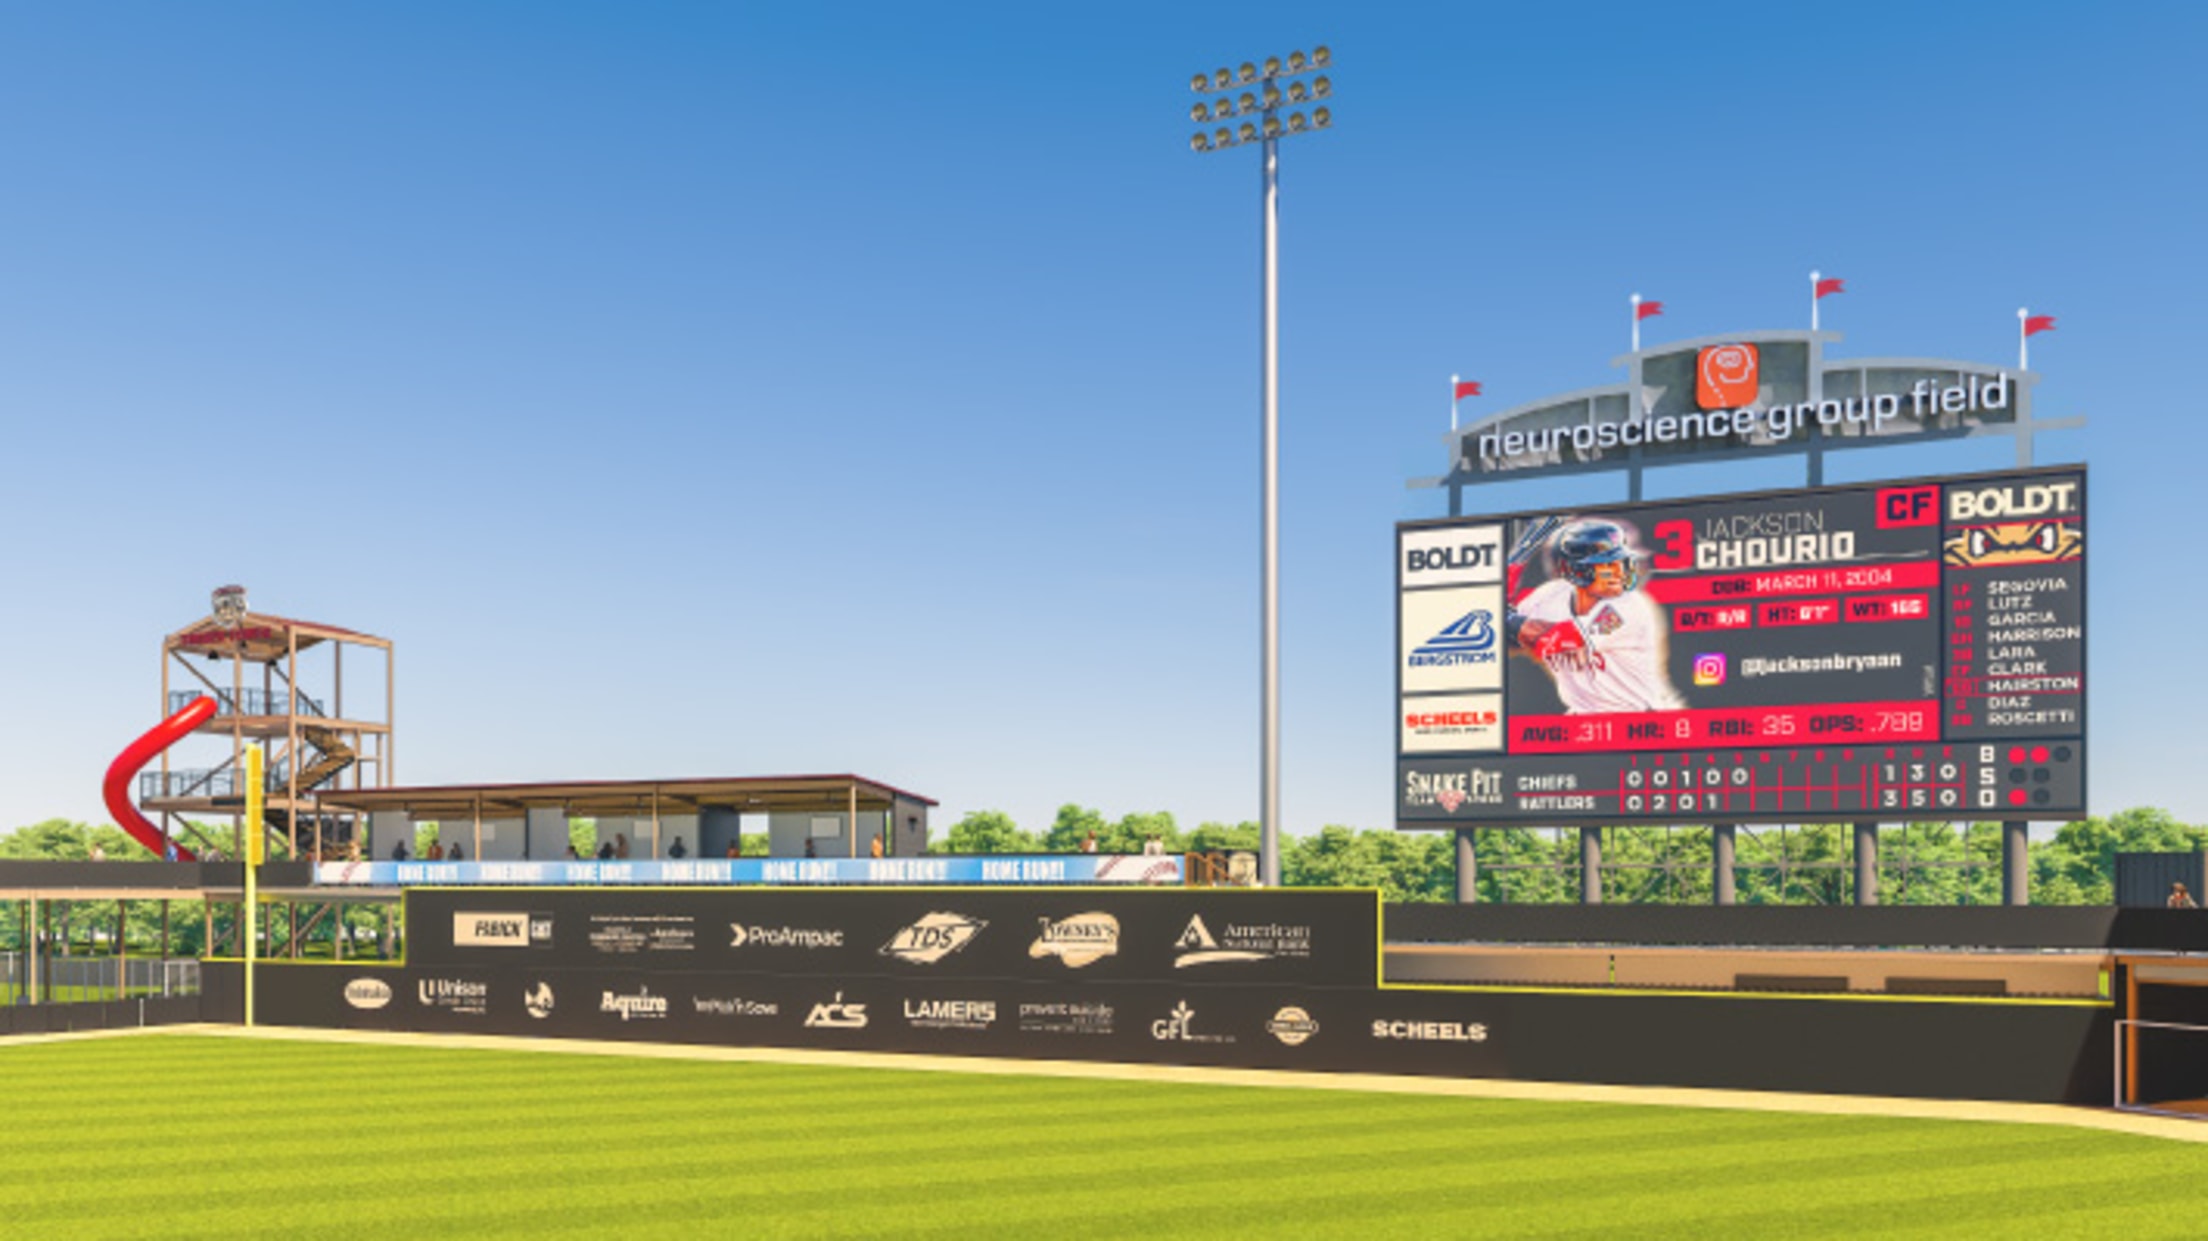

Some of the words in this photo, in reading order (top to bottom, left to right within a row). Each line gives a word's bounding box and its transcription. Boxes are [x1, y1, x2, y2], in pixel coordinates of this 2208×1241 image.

[1479, 407, 1755, 459] neuroscience
[1767, 393, 1899, 440] group
[1909, 371, 2008, 416] field
[1886, 490, 1933, 521] CF
[1653, 518, 1694, 570] 3
[1702, 509, 1824, 541] JACKSON
[1697, 531, 1855, 570] CHOURIO
[1407, 543, 1497, 572] BOLDT
[1755, 574, 1817, 593] MARCH
[1845, 568, 1893, 587] 2004
[1986, 577, 2068, 596] SEGOVIA
[1986, 595, 2033, 611] LUTZ
[1986, 610, 2057, 627] GARCIA
[1986, 626, 2082, 644] HARRISON
[1986, 646, 2036, 661] LARA
[1986, 660, 2048, 676] CLARK
[1986, 676, 2080, 693] HAIRSTON
[1986, 695, 2032, 710] DIAZ
[1405, 711, 1498, 729] SCHEELS
[1521, 726, 1569, 743] AVG:
[1575, 720, 1613, 743] .311
[1626, 722, 1665, 739] HR:
[1675, 717, 1692, 739] 8
[1708, 718, 1755, 737] RBI:
[1762, 714, 1796, 736] 35
[1809, 714, 1864, 734] OPS:
[1986, 709, 2076, 726] ROSCETTI
[1979, 745, 1995, 764] B
[1406, 770, 1469, 795] SNAKE
[1471, 767, 1504, 796] PIT
[1517, 773, 1577, 791] CHIEFS
[1626, 770, 1643, 787] 0
[1652, 770, 1668, 787] 0
[1680, 770, 1691, 787] 1
[1705, 769, 1721, 785] 0
[1731, 767, 1749, 785] 0
[1884, 764, 1895, 781] 1
[1910, 763, 1925, 782] 3
[1939, 763, 1957, 780] 0
[1979, 767, 1996, 785] S
[1626, 794, 1643, 811] 0
[1652, 794, 1667, 810] 2
[1678, 793, 1695, 811] 0
[1706, 793, 1717, 810] 1
[1883, 789, 1899, 807] 3
[1911, 789, 1926, 807] 5
[1939, 789, 1957, 806] 0
[749, 926, 844, 948] ProAmpac
[908, 926, 957, 950] TDS
[1223, 923, 1311, 938] American
[904, 999, 997, 1022] LAMERS
[1151, 1018, 1193, 1041] GFL
[1372, 1019, 1488, 1042] SCHEELS
